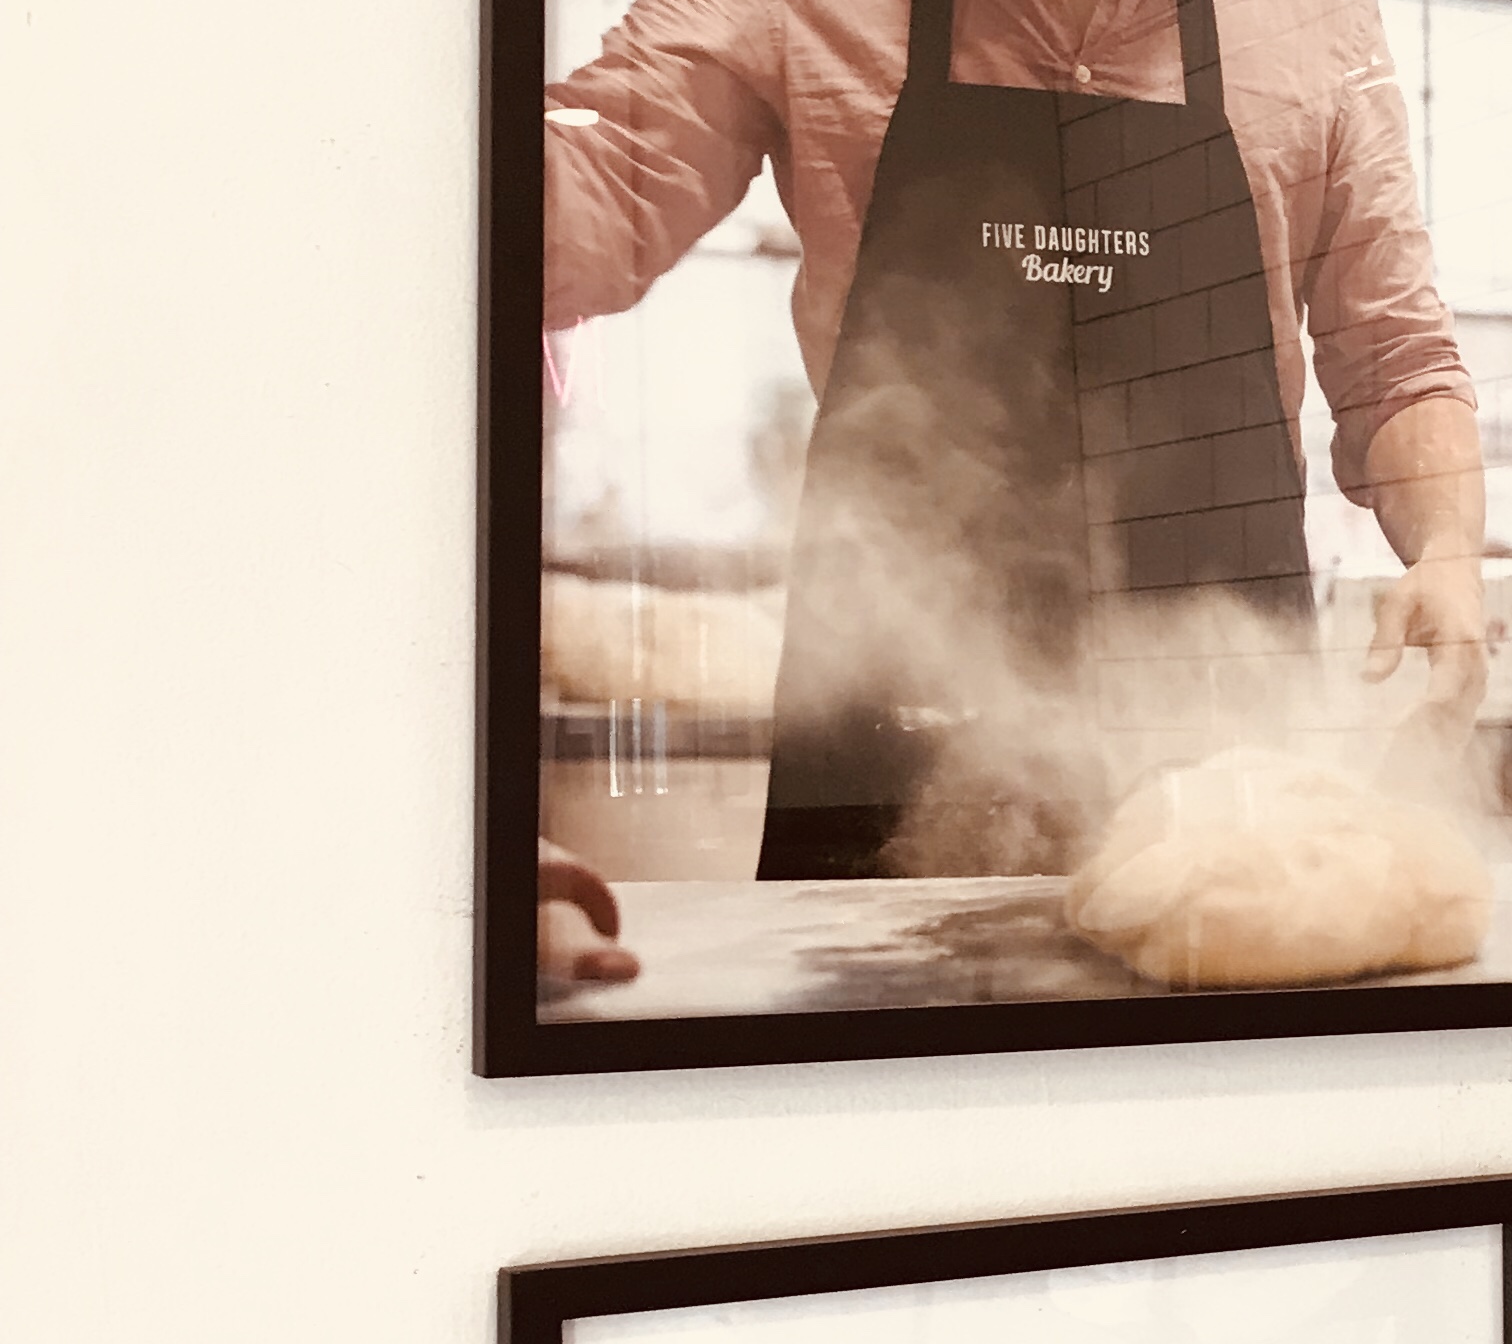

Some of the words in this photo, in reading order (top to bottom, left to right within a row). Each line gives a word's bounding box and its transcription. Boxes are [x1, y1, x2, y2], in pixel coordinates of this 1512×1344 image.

[982, 222, 1026, 249] FIVE
[1034, 225, 1150, 256] DAUGHTERS
[1021, 253, 1114, 293] Bakery
